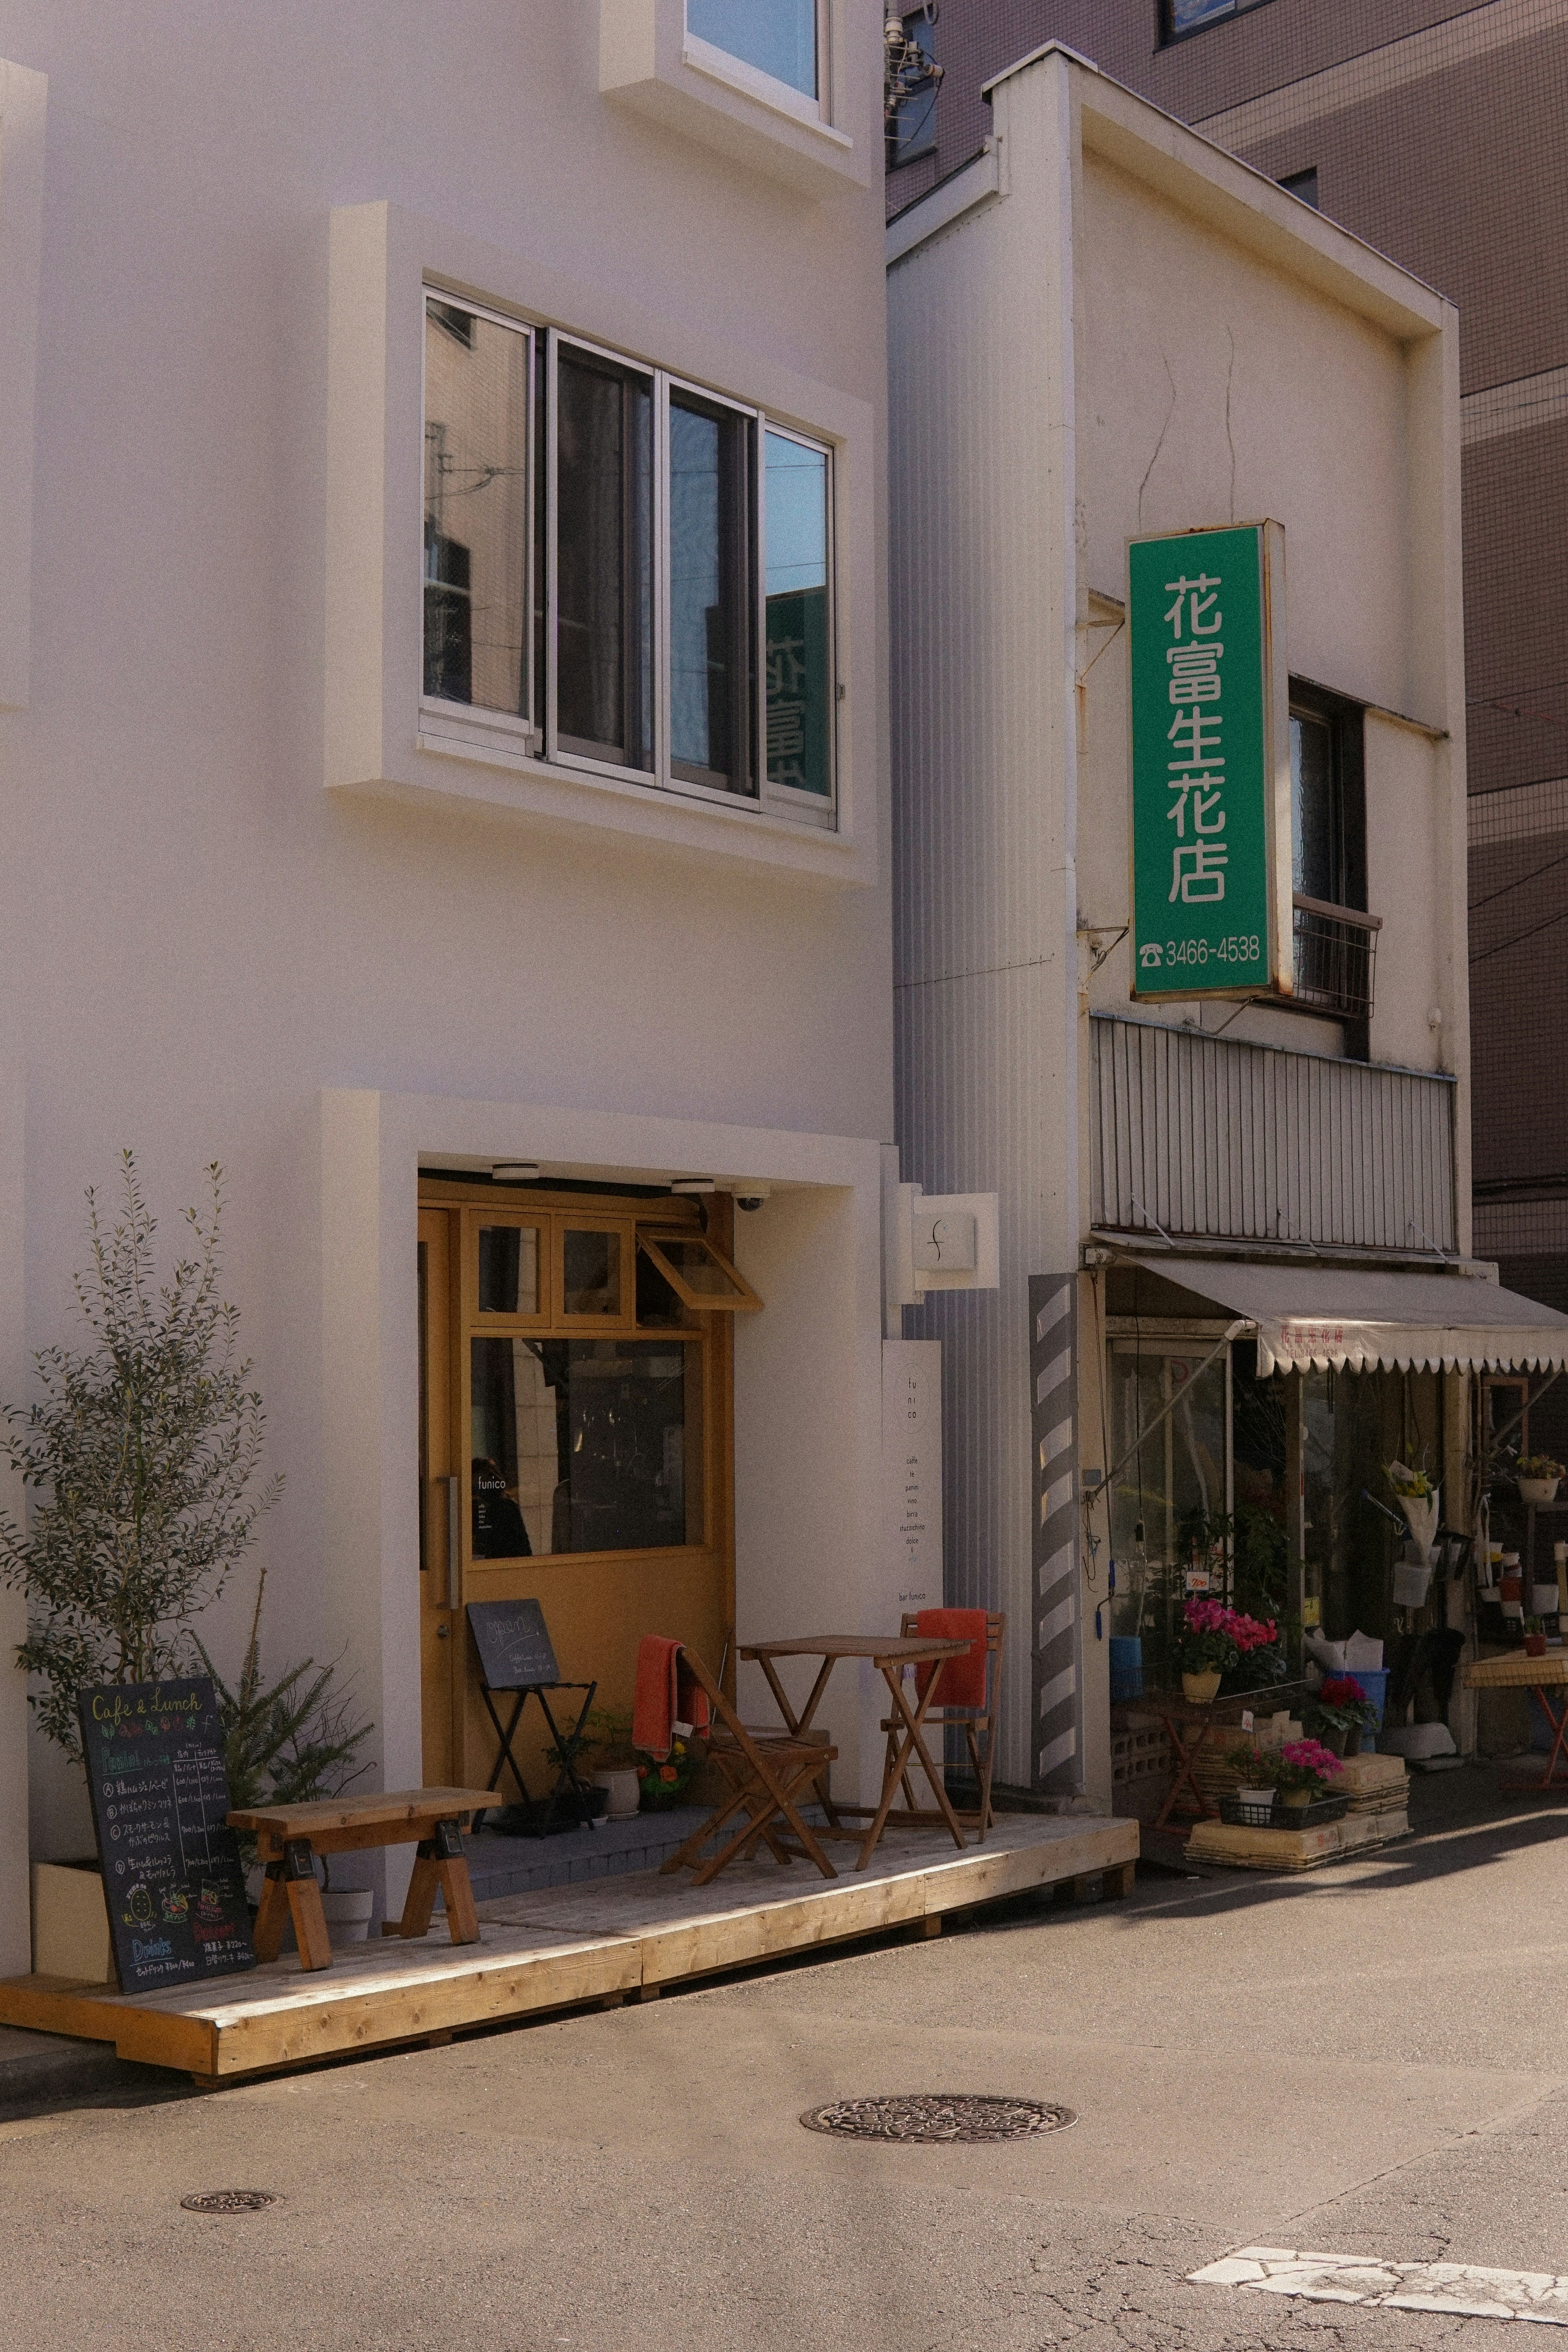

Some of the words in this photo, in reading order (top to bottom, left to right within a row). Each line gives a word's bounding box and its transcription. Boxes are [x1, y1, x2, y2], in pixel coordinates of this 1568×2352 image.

[1164, 572, 1228, 903] 花富生花店
[1166, 935, 1260, 966] 3466-4538
[1281, 1325, 1343, 1344] 花富生花店
[478, 1475, 505, 1490] funico
[900, 1524, 925, 1532] stuzzichino
[899, 1592, 908, 1602] bar
[909, 1591, 926, 1600] funico
[92, 1695, 132, 1726] Cafe
[137, 1699, 147, 1714] &
[150, 1687, 202, 1712] Lunch
[177, 1749, 189, 1758] 店内
[132, 1937, 171, 1963] Drinks
